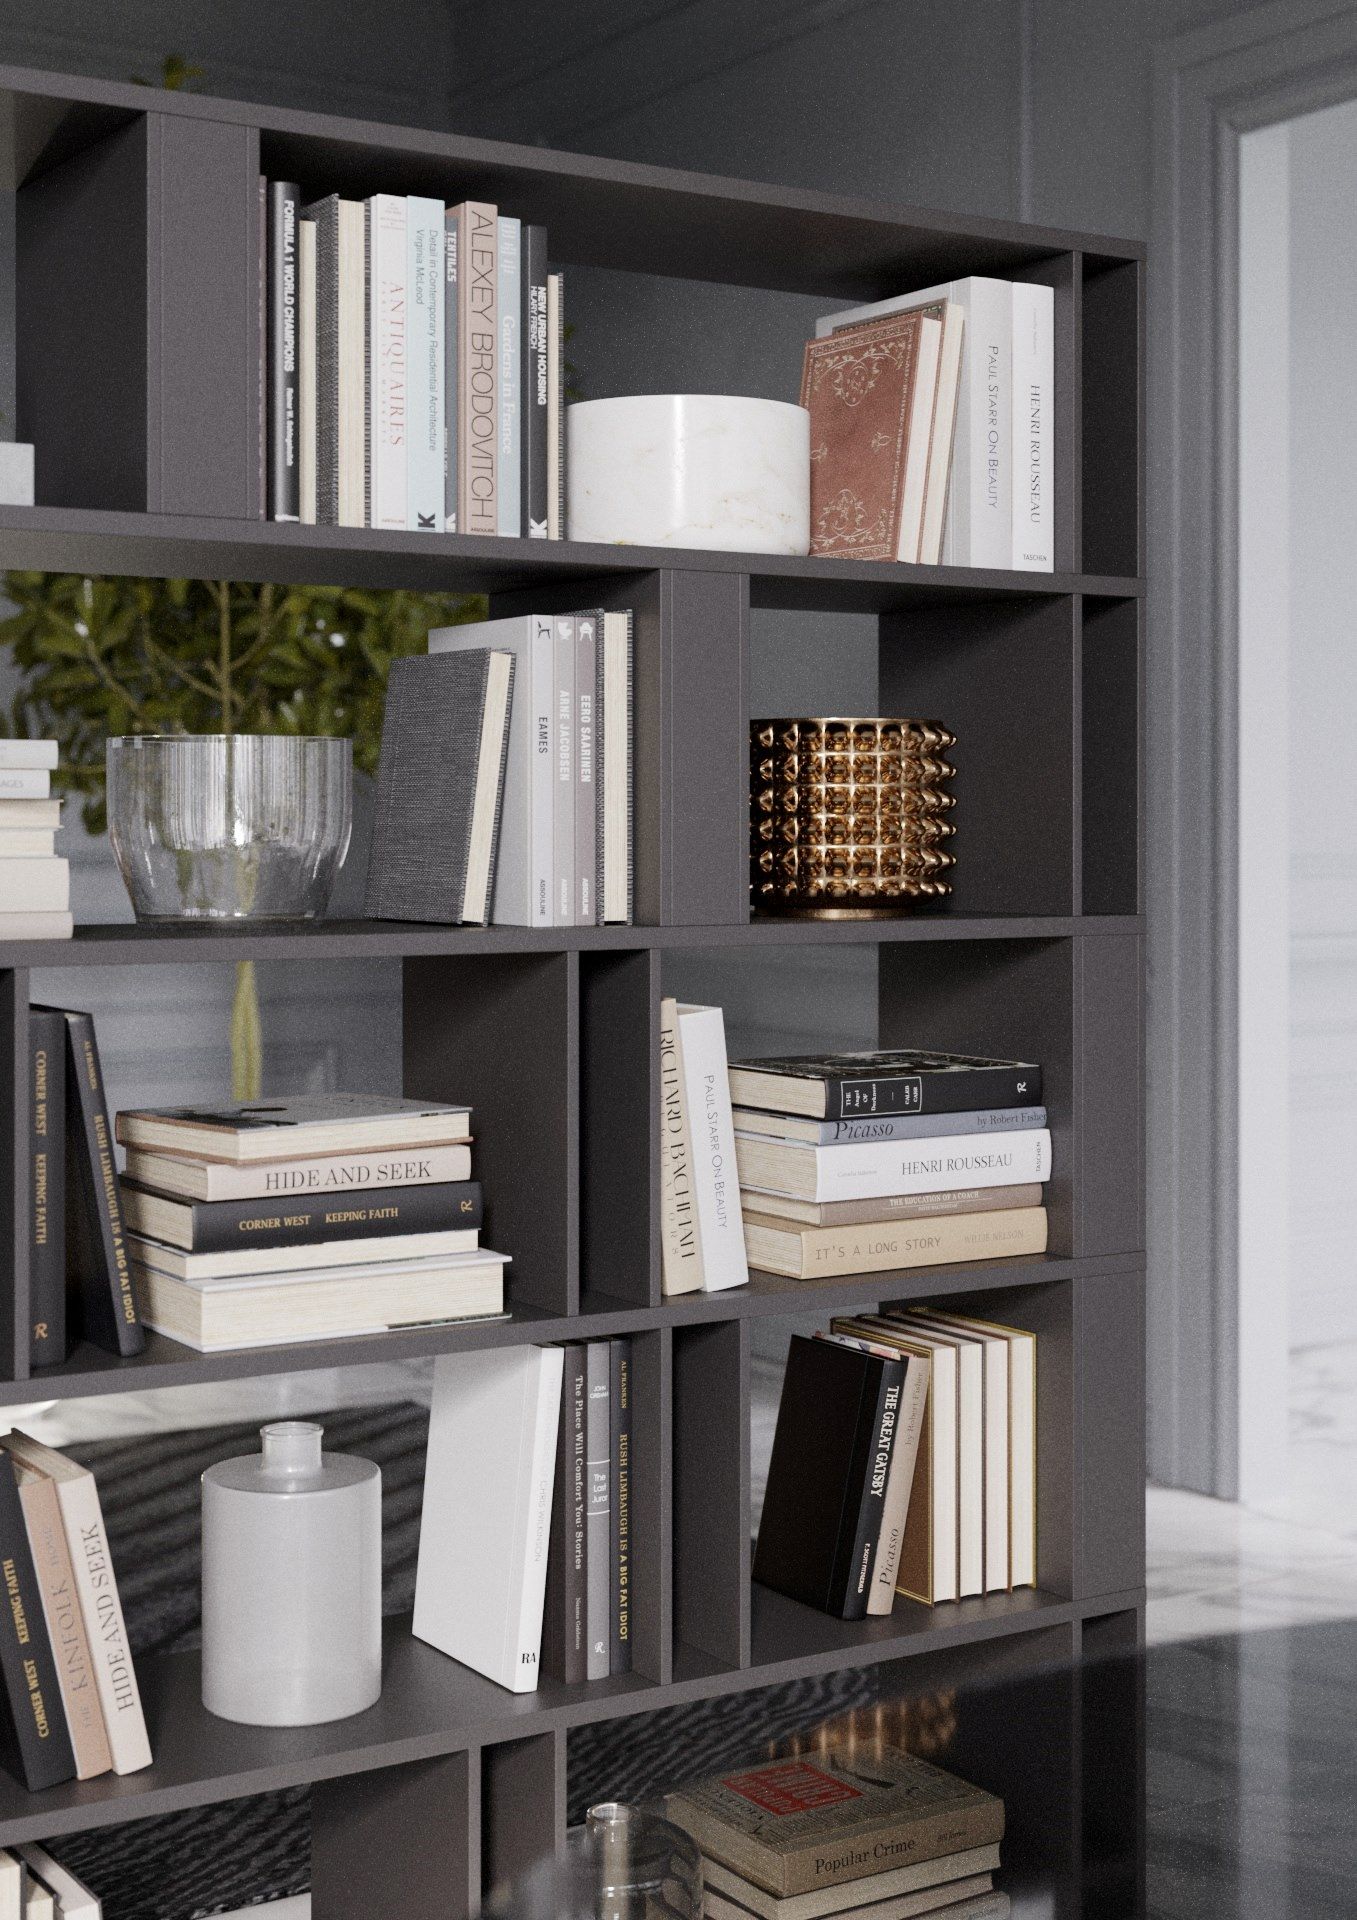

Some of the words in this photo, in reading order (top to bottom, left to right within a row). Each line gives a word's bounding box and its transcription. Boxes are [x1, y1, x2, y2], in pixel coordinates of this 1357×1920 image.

[283, 199, 295, 254] FORMULA
[428, 229, 438, 257] Detail
[284, 255, 295, 263] 1
[414, 229, 425, 263] Virginia
[429, 259, 438, 268] in
[283, 264, 295, 304] WORLD
[416, 266, 425, 305] McLeod
[471, 210, 494, 324] ALEXEY
[427, 270, 438, 336] Contemporary
[530, 286, 538, 314] HILARY
[537, 286, 547, 313] NEW
[283, 306, 295, 373] CHAMPIONS
[502, 315, 515, 378] Gardens
[530, 315, 538, 349] FRENCH
[537, 313, 547, 353] URBAN
[386, 281, 405, 446] ANTIQUAIRES
[429, 340, 438, 393] Residential
[537, 355, 547, 405] HOUSING
[988, 345, 999, 381] PAUL
[504, 383, 516, 398] in
[988, 384, 999, 426] STARR
[429, 395, 438, 452] Architecture
[471, 332, 494, 519] BRODOVITCH
[503, 403, 516, 454] France
[1030, 385, 1041, 435] HENRI
[988, 430, 999, 454] ON
[988, 459, 999, 509] BEAUTY
[1030, 440, 1041, 525] ROUSSEAU
[559, 689, 570, 720] ARNE
[580, 694, 592, 724] EERO
[538, 716, 549, 754] EAMES
[559, 723, 570, 782] JACOBSEN
[580, 726, 592, 783] SAARINEN
[539, 878, 547, 916] ASSOULINE
[35, 1049, 48, 1101] CORNER
[660, 1029, 683, 1135] RICHARD
[703, 1073, 715, 1110] PAUL
[36, 1102, 48, 1137] WEST
[93, 1113, 109, 1150] RUSH
[706, 1111, 719, 1152] STARR
[834, 1120, 895, 1140] Picasso
[977, 1115, 988, 1128] by
[989, 1112, 1019, 1126] Robert
[1020, 1110, 1048, 1123] Fisher
[35, 1153, 48, 1204] KEEPING
[265, 1168, 320, 1191] HIDE
[324, 1164, 371, 1186] AND
[376, 1160, 433, 1182] SEEK
[711, 1154, 723, 1178] ON
[901, 1158, 942, 1176] HENRI
[946, 1153, 1014, 1172] ROUSSEAU
[99, 1151, 120, 1218] LIMBAUGH
[669, 1143, 696, 1259] BACHMAN
[889, 1198, 903, 1207] THE
[904, 1194, 941, 1206] EDUCATION
[942, 1193, 951, 1202] OF
[958, 1190, 980, 1201] COACH
[238, 1217, 281, 1232] CORNER
[283, 1214, 311, 1228] WEST
[325, 1208, 367, 1224] KEEPING
[368, 1206, 399, 1219] FAITH
[714, 1181, 728, 1229] BEAUTY
[36, 1206, 48, 1244] FAITH
[113, 1237, 124, 1247] A
[992, 1228, 1024, 1242] NELSON
[115, 1248, 128, 1270] BIG
[815, 1245, 846, 1261] IT'S
[853, 1247, 861, 1256] A
[868, 1241, 899, 1256] LONG
[905, 1237, 942, 1251] STORY
[118, 1271, 131, 1292] FAT
[122, 1293, 136, 1325] IDIOT
[621, 1360, 628, 1372] AL
[574, 1375, 584, 1397] The
[884, 1385, 900, 1411] THE
[574, 1400, 584, 1429] Place
[877, 1411, 896, 1452] GREAT
[574, 1431, 584, 1455] Will
[619, 1433, 628, 1467] RUSH
[574, 1458, 584, 1501] Comfort
[593, 1483, 607, 1493] Last
[594, 1472, 607, 1482] The
[870, 1451, 889, 1498] GATSBY
[574, 1503, 584, 1527] You:
[591, 1494, 609, 1504] Juror
[618, 1470, 628, 1535] LIMBAUGH
[81, 1522, 109, 1590] SEEK
[574, 1530, 584, 1570] Stories
[619, 1538, 628, 1551] IS
[619, 1554, 628, 1563] A
[879, 1528, 899, 1587] Picasso
[3, 1558, 20, 1596] FAITH
[619, 1565, 628, 1586] BIG
[619, 1588, 628, 1608] FAT
[10, 1595, 30, 1645] KEEPING
[51, 1578, 89, 1692] KINFOLK
[95, 1593, 122, 1643] AND
[619, 1611, 628, 1641] IDIOT
[23, 1659, 40, 1692] WEST
[521, 1652, 537, 1664] RA
[107, 1648, 135, 1711] HIDE
[30, 1690, 50, 1738] CORNER
[814, 1850, 870, 1875] Popular
[872, 1838, 916, 1859] Crime
